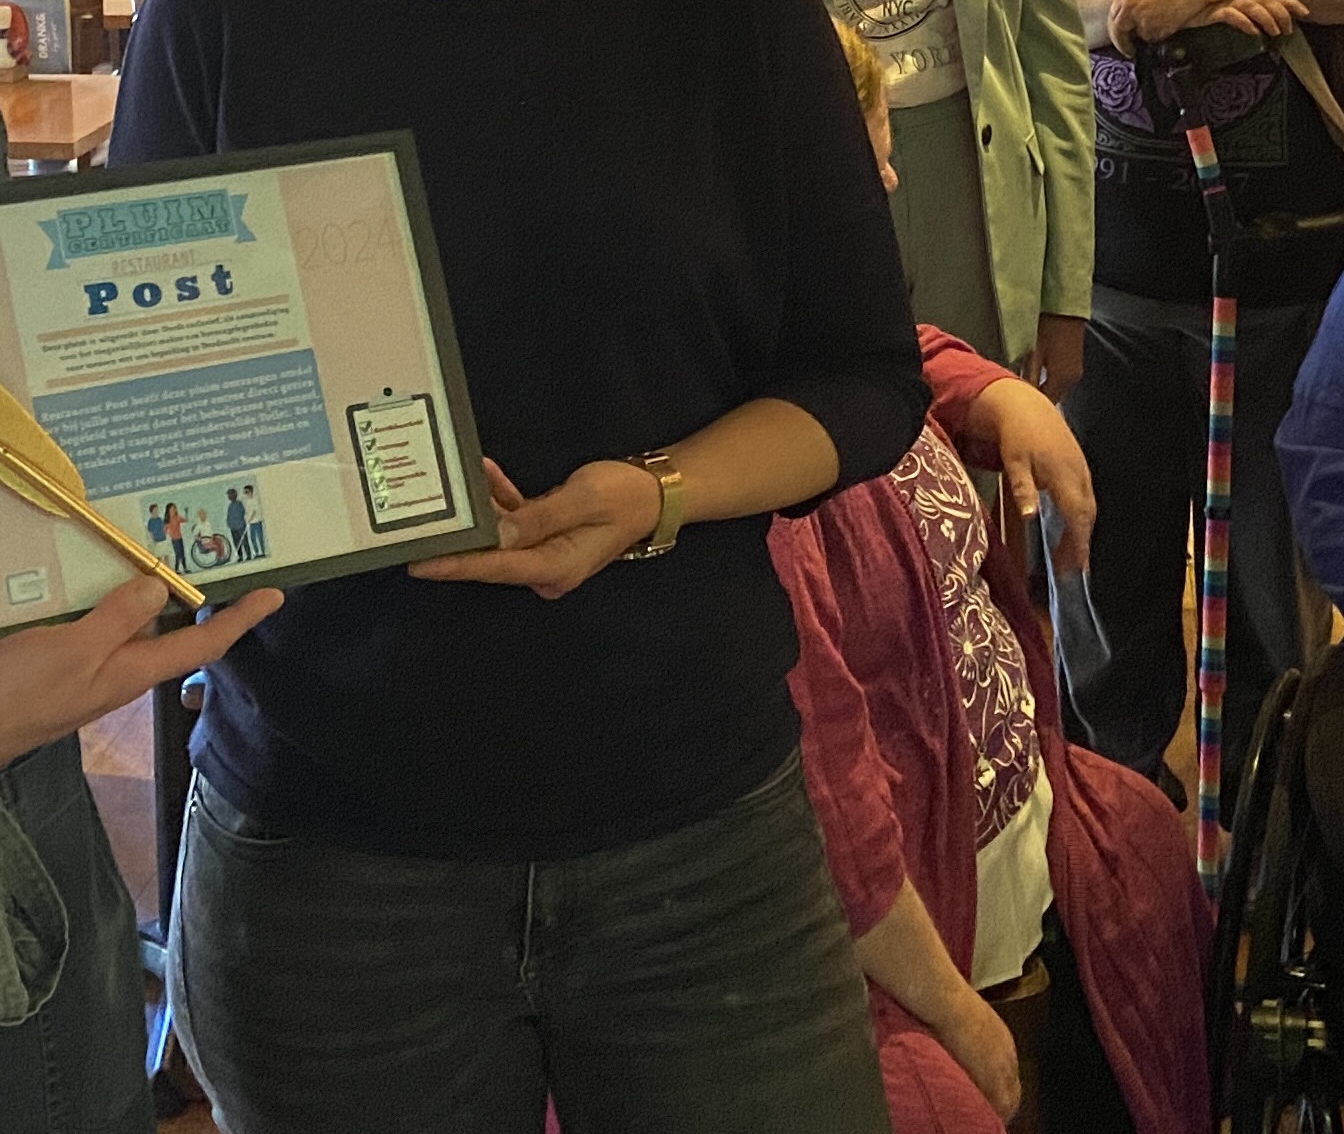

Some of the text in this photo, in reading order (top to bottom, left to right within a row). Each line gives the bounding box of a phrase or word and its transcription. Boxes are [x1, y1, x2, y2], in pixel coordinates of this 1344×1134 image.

[882, 0, 914, 17] NYC
[62, 192, 228, 239] PLUIM
[67, 218, 232, 254] CERTIFICAAT
[112, 250, 195, 277] RESTAURANT
[84, 264, 234, 315] Post
